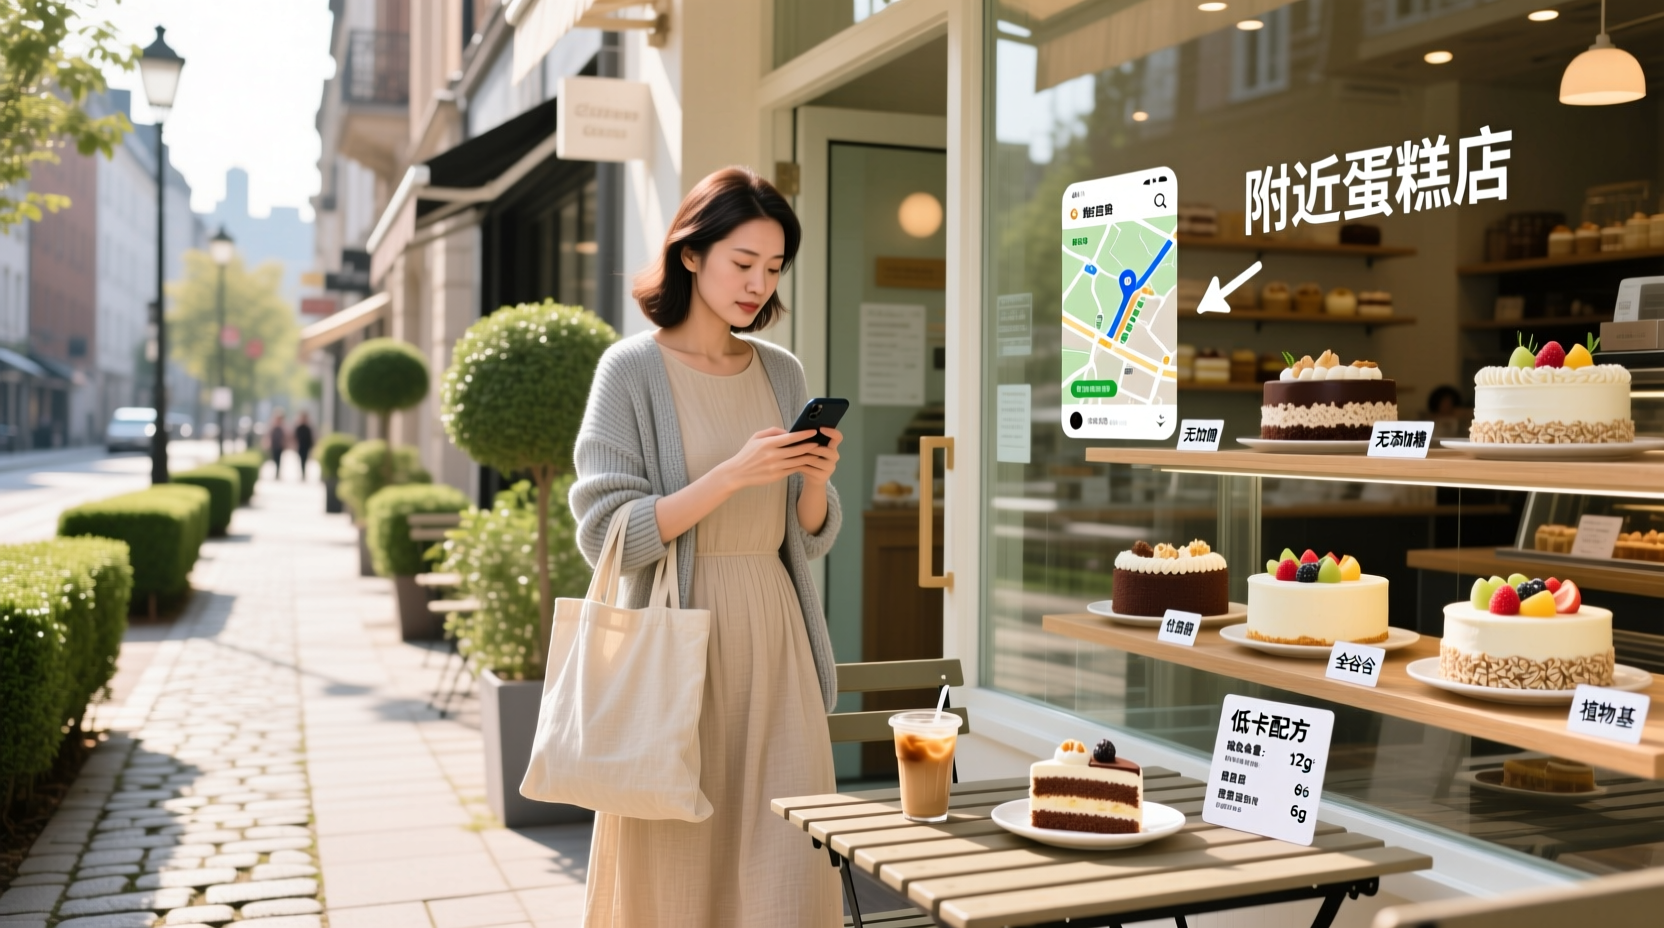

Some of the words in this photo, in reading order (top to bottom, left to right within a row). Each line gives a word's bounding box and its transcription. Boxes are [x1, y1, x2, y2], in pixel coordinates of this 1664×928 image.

[1245, 125, 1512, 236] 附近蛋糕店
[1231, 709, 1311, 743] 低卡配方
[1579, 699, 1636, 729] 植物基
[1290, 804, 1307, 823] 6g
